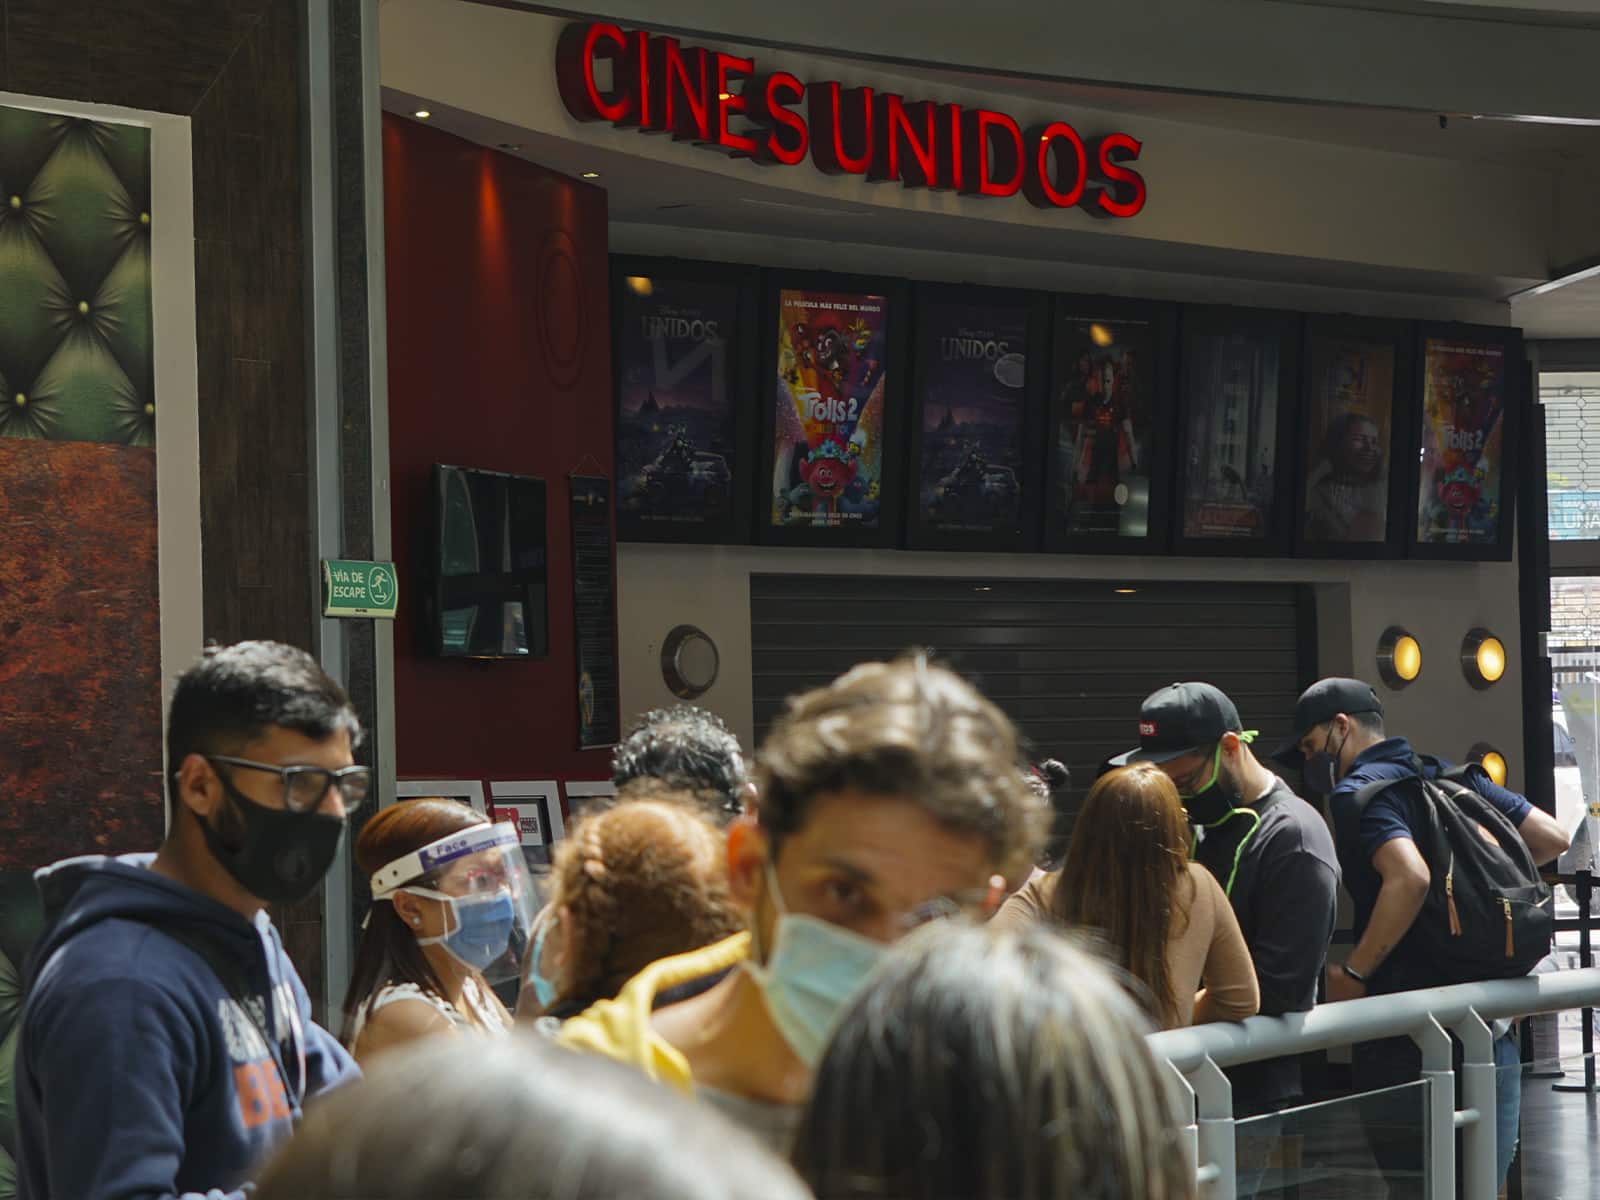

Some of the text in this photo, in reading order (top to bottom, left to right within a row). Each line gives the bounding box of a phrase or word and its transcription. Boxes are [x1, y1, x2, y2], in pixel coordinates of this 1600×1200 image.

[847, 397, 858, 421] 2
[1474, 428, 1484, 449] 2
[352, 571, 364, 584] DE
[333, 585, 366, 599] ESCAPE
